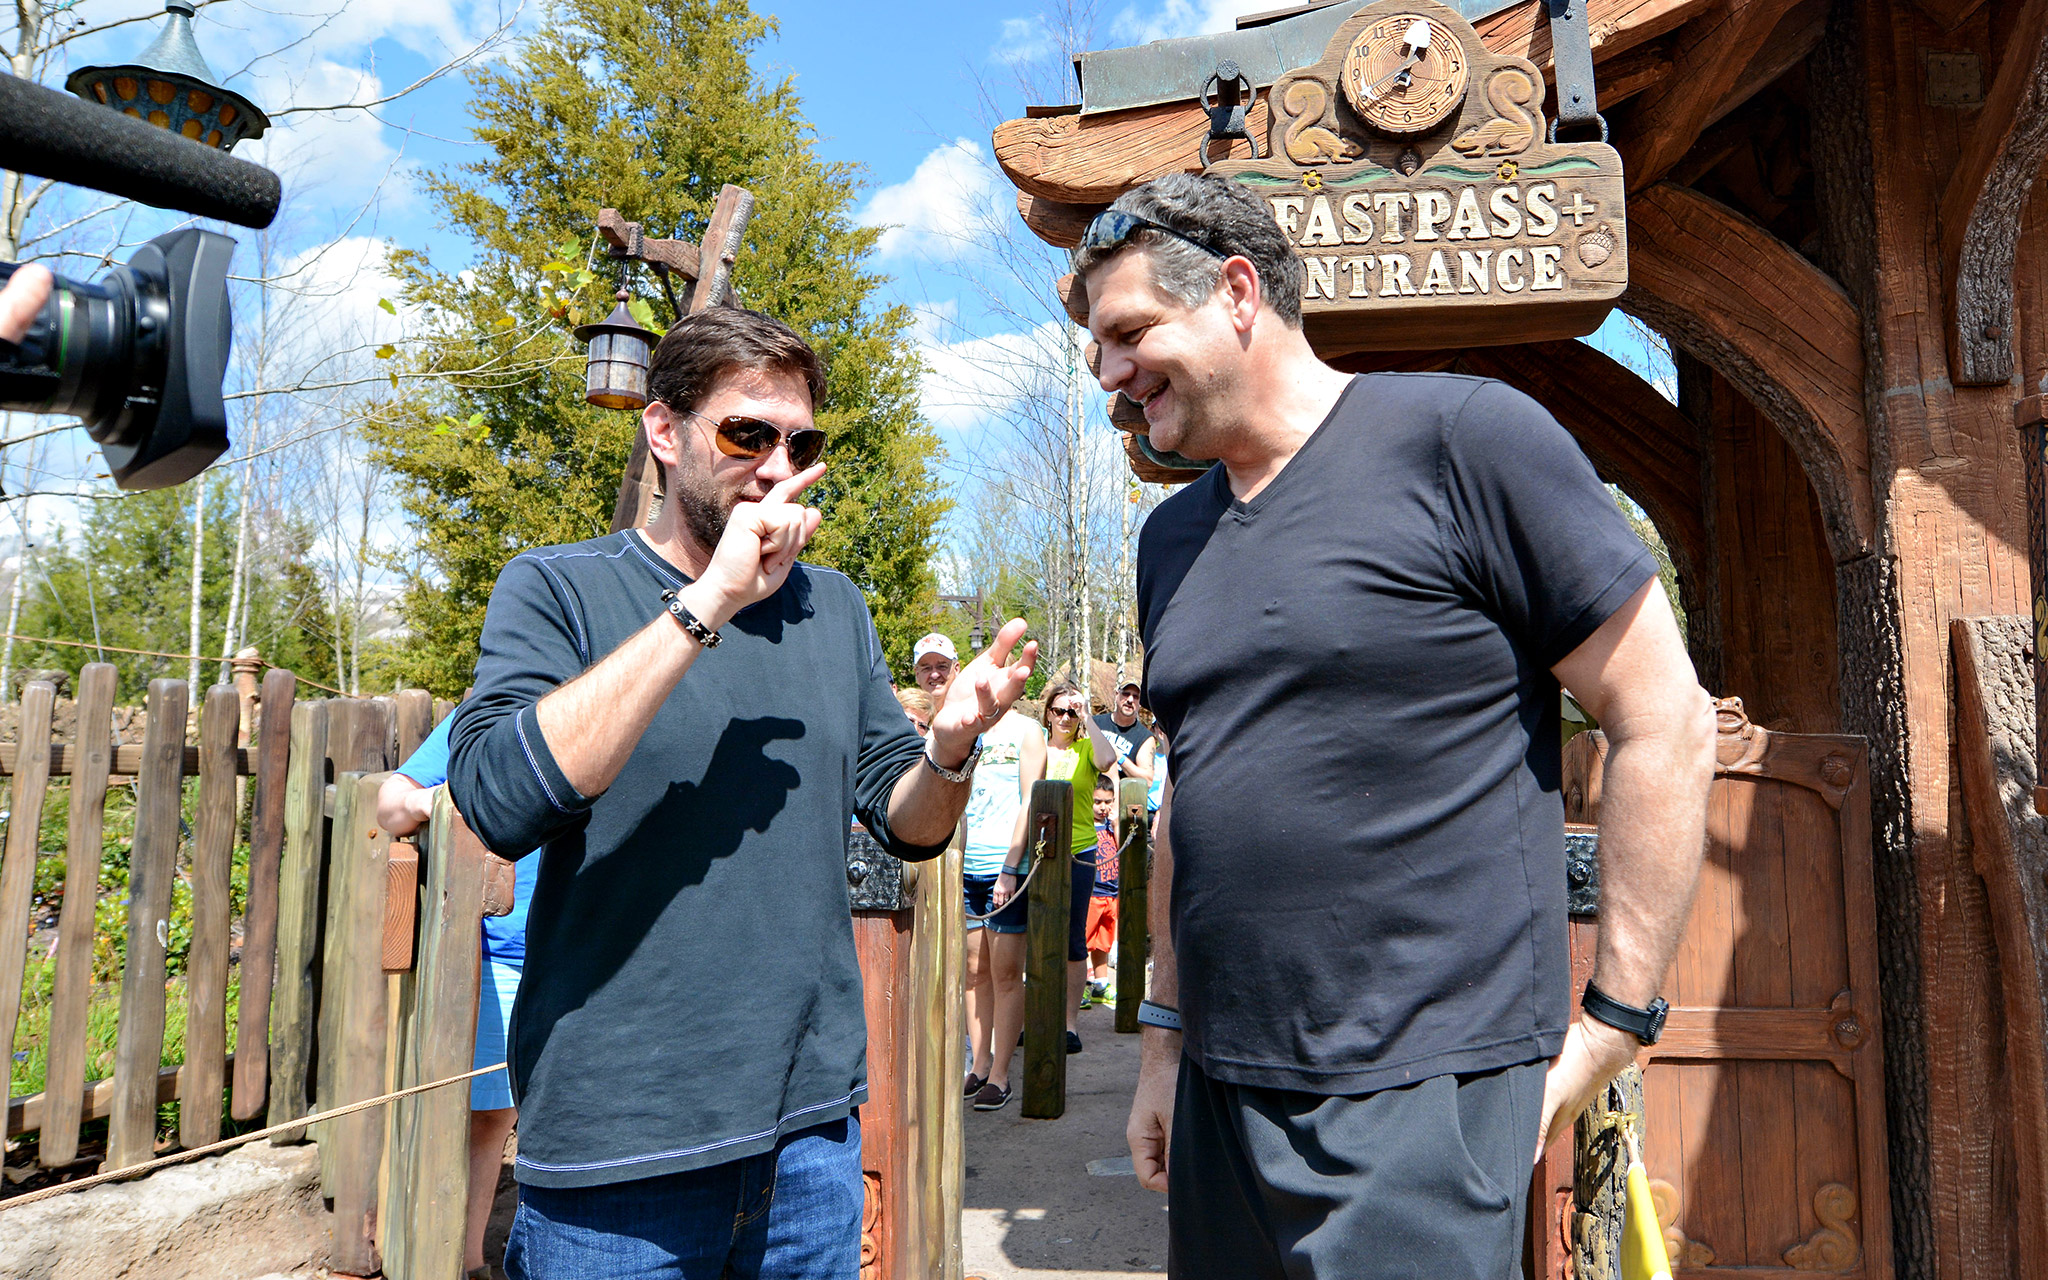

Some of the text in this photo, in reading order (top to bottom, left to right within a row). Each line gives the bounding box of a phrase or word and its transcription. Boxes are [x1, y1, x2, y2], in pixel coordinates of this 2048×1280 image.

[1373, 26, 1386, 39] 11
[1355, 45, 1369, 58] 10
[1443, 39, 1451, 52] 2
[1451, 61, 1460, 74] 3
[1352, 68, 1361, 81] 9
[1445, 83, 1454, 97] 4
[1379, 106, 1387, 120] 7
[1428, 102, 1438, 115] 5
[1403, 110, 1412, 123] 6
[1303, 246, 1563, 299] NTRANCE
